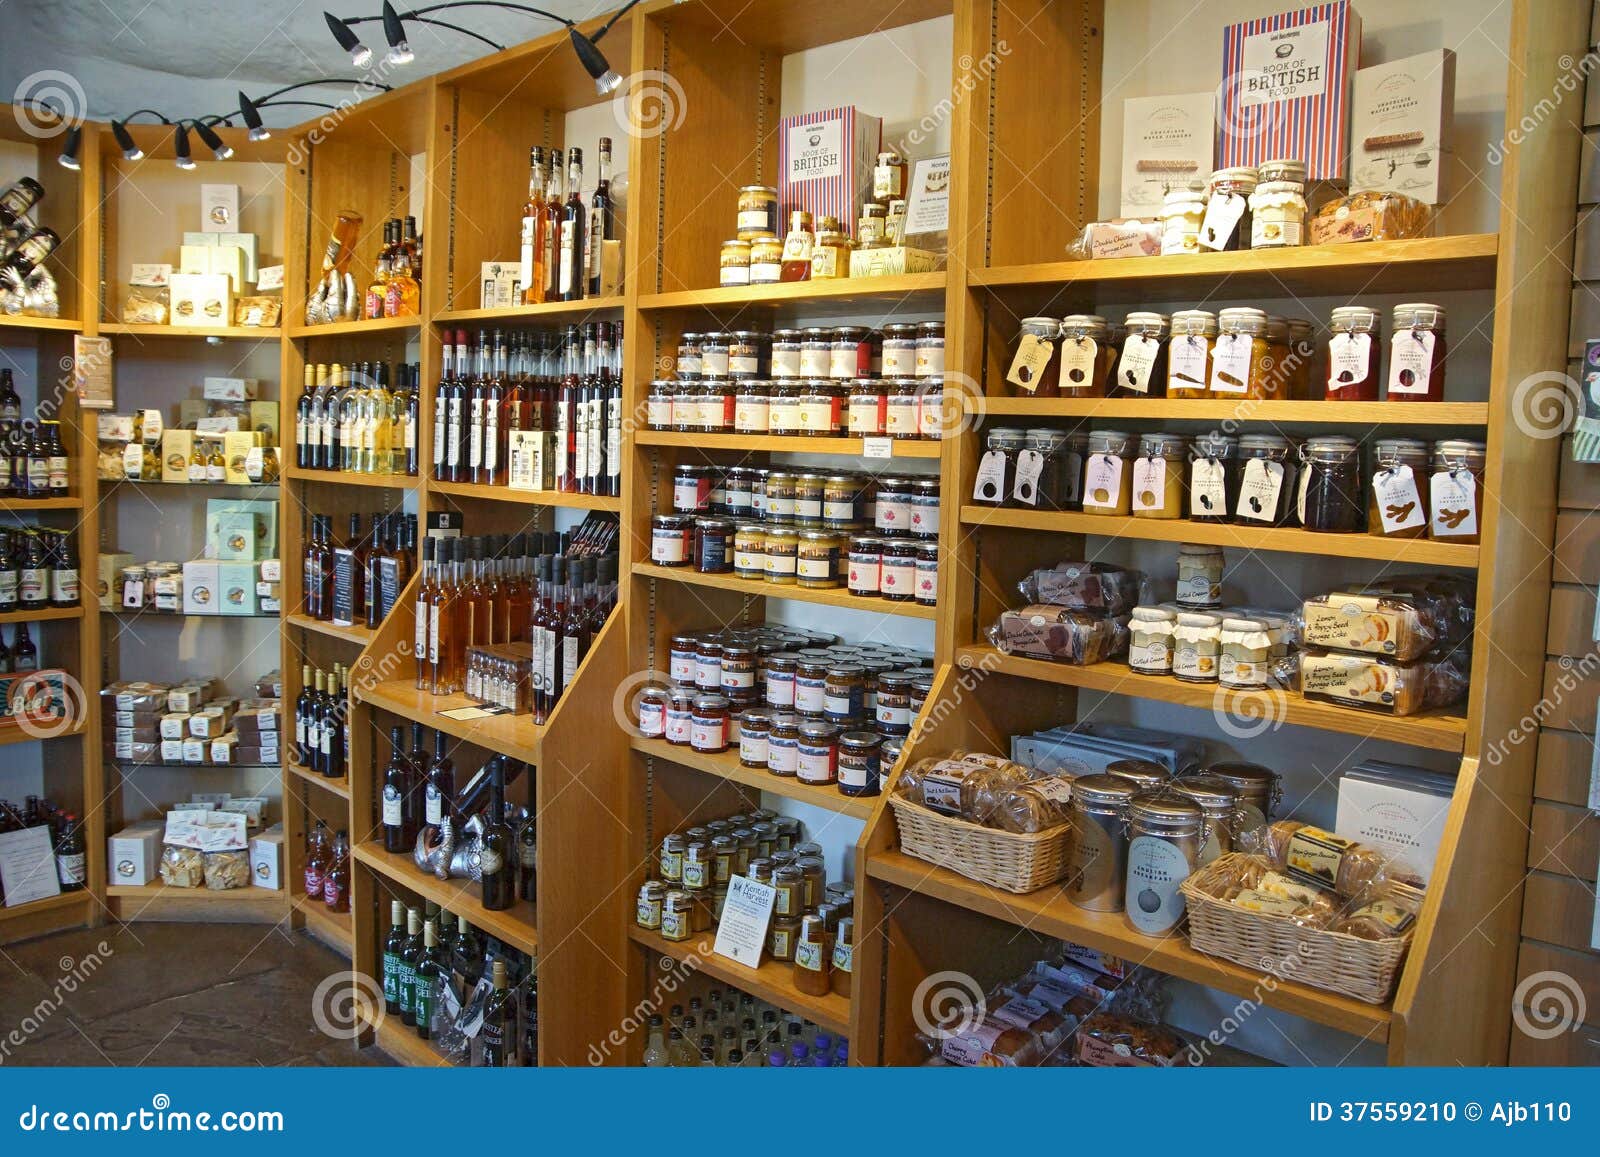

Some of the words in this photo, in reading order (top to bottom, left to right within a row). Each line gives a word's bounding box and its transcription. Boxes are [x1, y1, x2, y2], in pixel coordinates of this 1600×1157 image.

[1263, 61, 1289, 74] BOOK
[1292, 59, 1305, 69] OF
[1248, 66, 1320, 92] BRITISH
[1269, 86, 1297, 97] FOOD
[793, 153, 838, 171] BRITISH
[1333, 621, 1349, 629] Seed
[1308, 633, 1331, 642] Sponge
[1314, 665, 1334, 673] Lemon
[1332, 670, 1348, 678] Seed
[1307, 682, 1330, 691] Sponge
[744, 882, 769, 898] Kentish
[742, 890, 769, 905] Harvest
